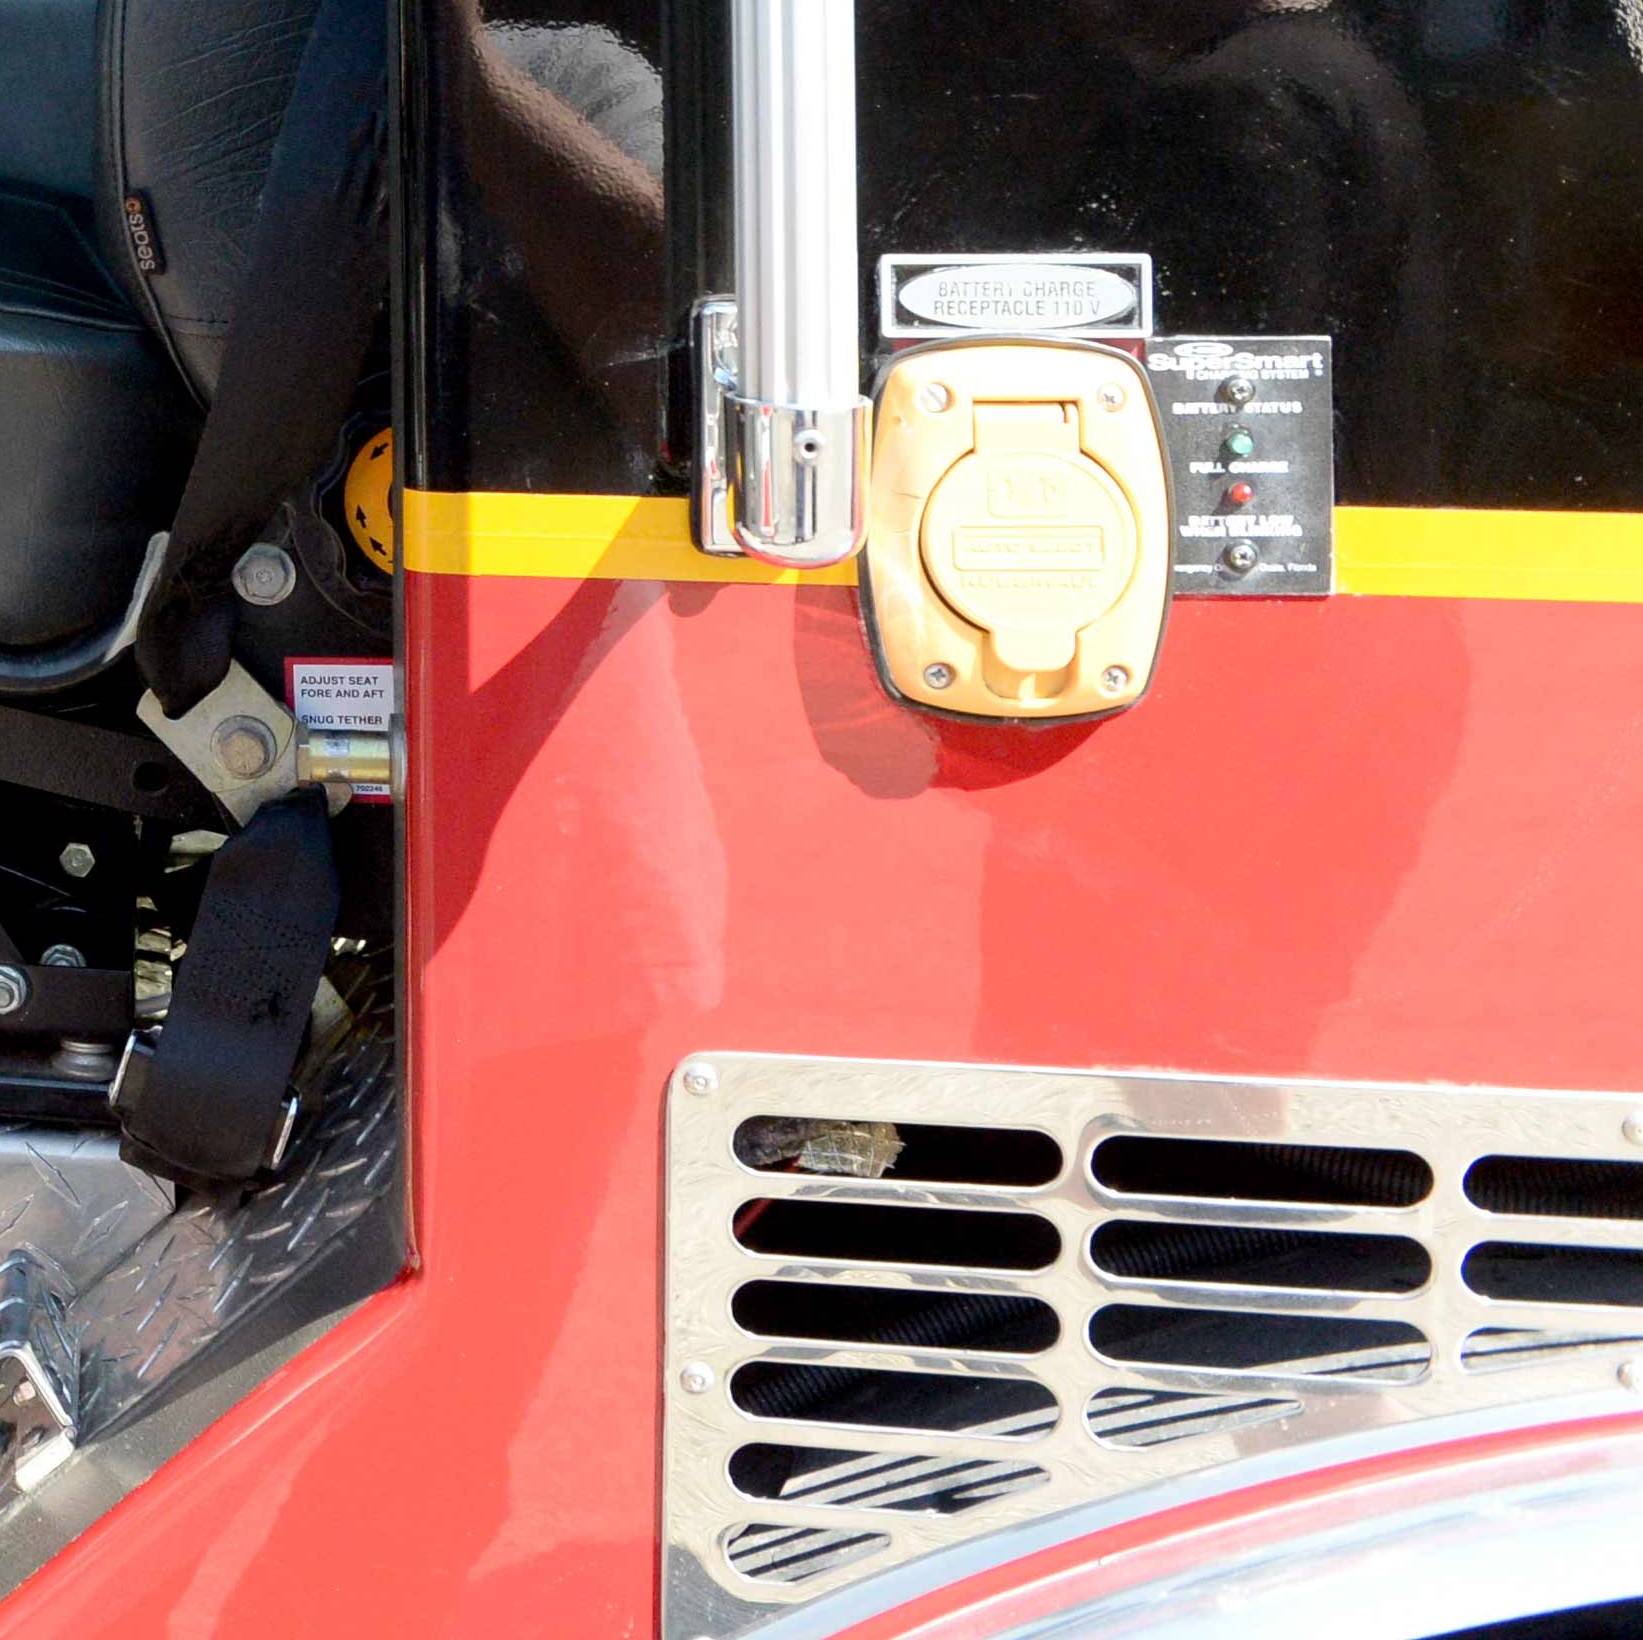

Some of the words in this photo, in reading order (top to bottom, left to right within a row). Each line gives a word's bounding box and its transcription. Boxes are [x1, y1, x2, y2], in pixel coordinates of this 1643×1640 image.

[938, 281, 1013, 298] BATTERY
[1023, 281, 1096, 298] CHARGE
[933, 300, 1044, 316] RECEPTACLE
[1054, 300, 1083, 316] 110
[1089, 300, 1100, 316] V
[1147, 352, 1323, 380] SuperSmart
[1260, 369, 1309, 380] SYSTEM
[1243, 401, 1303, 414] STATUS
[1189, 461, 1226, 474] FULL
[1228, 461, 1289, 474] CHARGE
[300, 676, 345, 686] ADJUST
[348, 676, 379, 686] SEAT
[300, 689, 332, 698] FORE
[335, 689, 360, 698] AND
[363, 689, 384, 698] AFT
[301, 715, 334, 725] SNUG
[338, 715, 383, 725] TETHER
